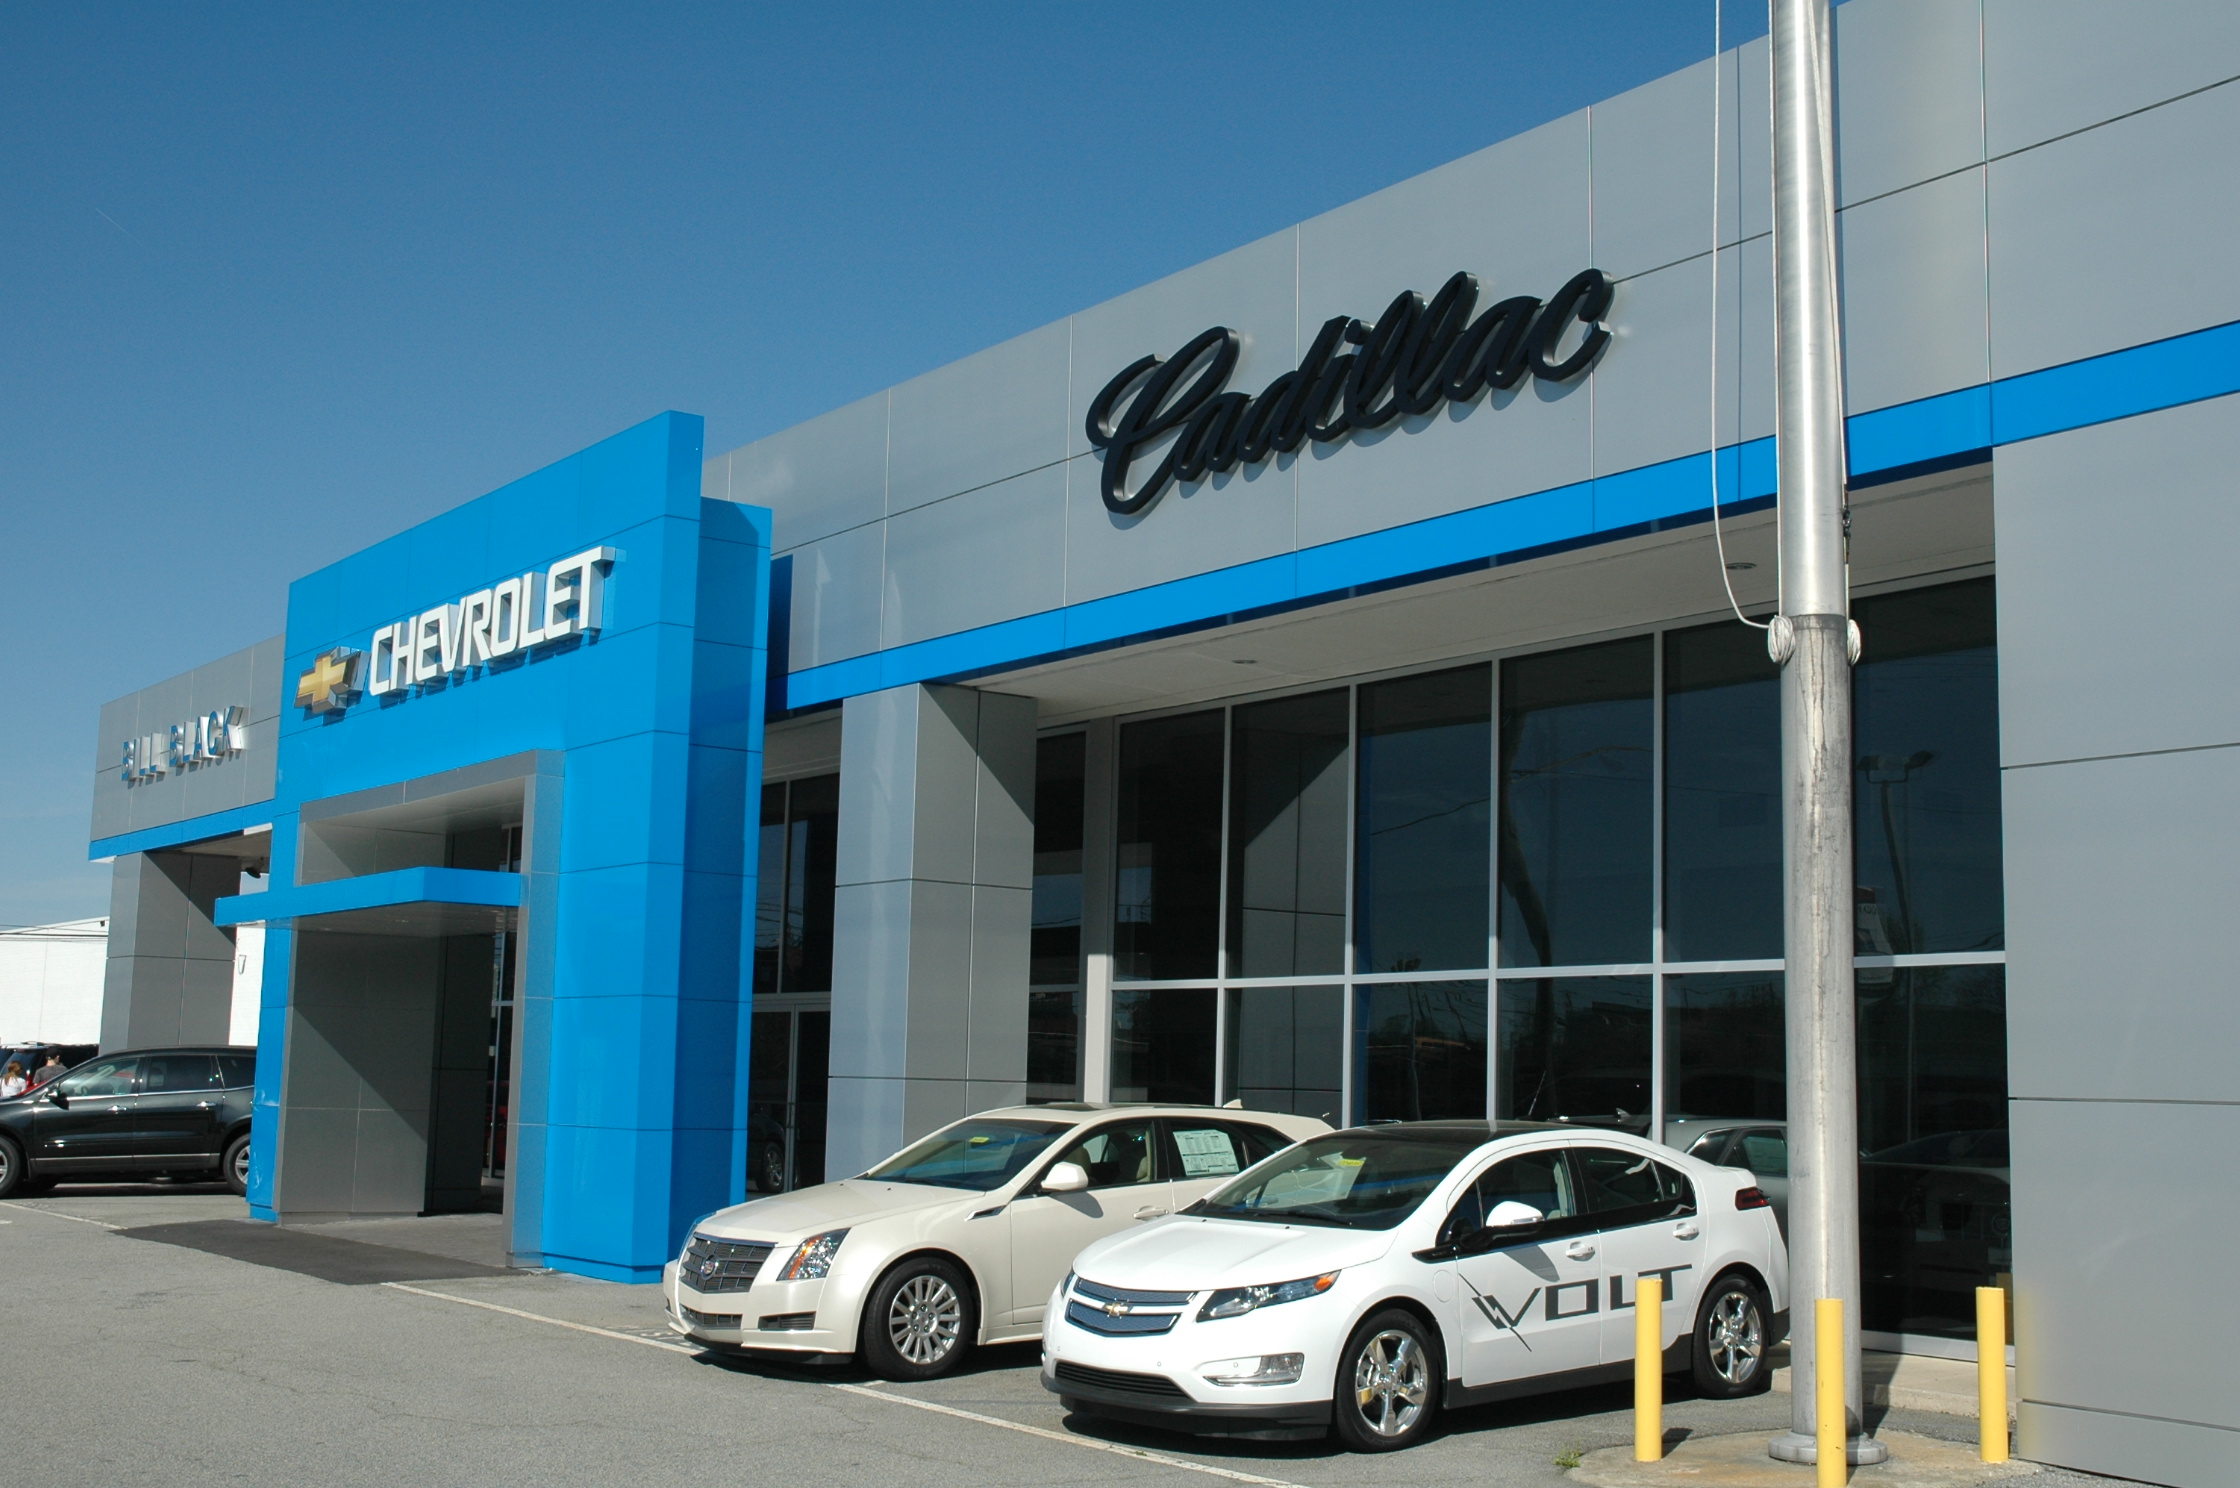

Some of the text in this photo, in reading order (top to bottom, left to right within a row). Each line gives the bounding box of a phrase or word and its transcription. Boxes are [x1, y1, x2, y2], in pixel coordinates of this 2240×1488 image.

[1085, 268, 1613, 515] Cadillac
[368, 545, 611, 697] CHEVROLET
[121, 705, 243, 782] BILL BLACK
[1460, 1264, 1692, 1350] VOLT
